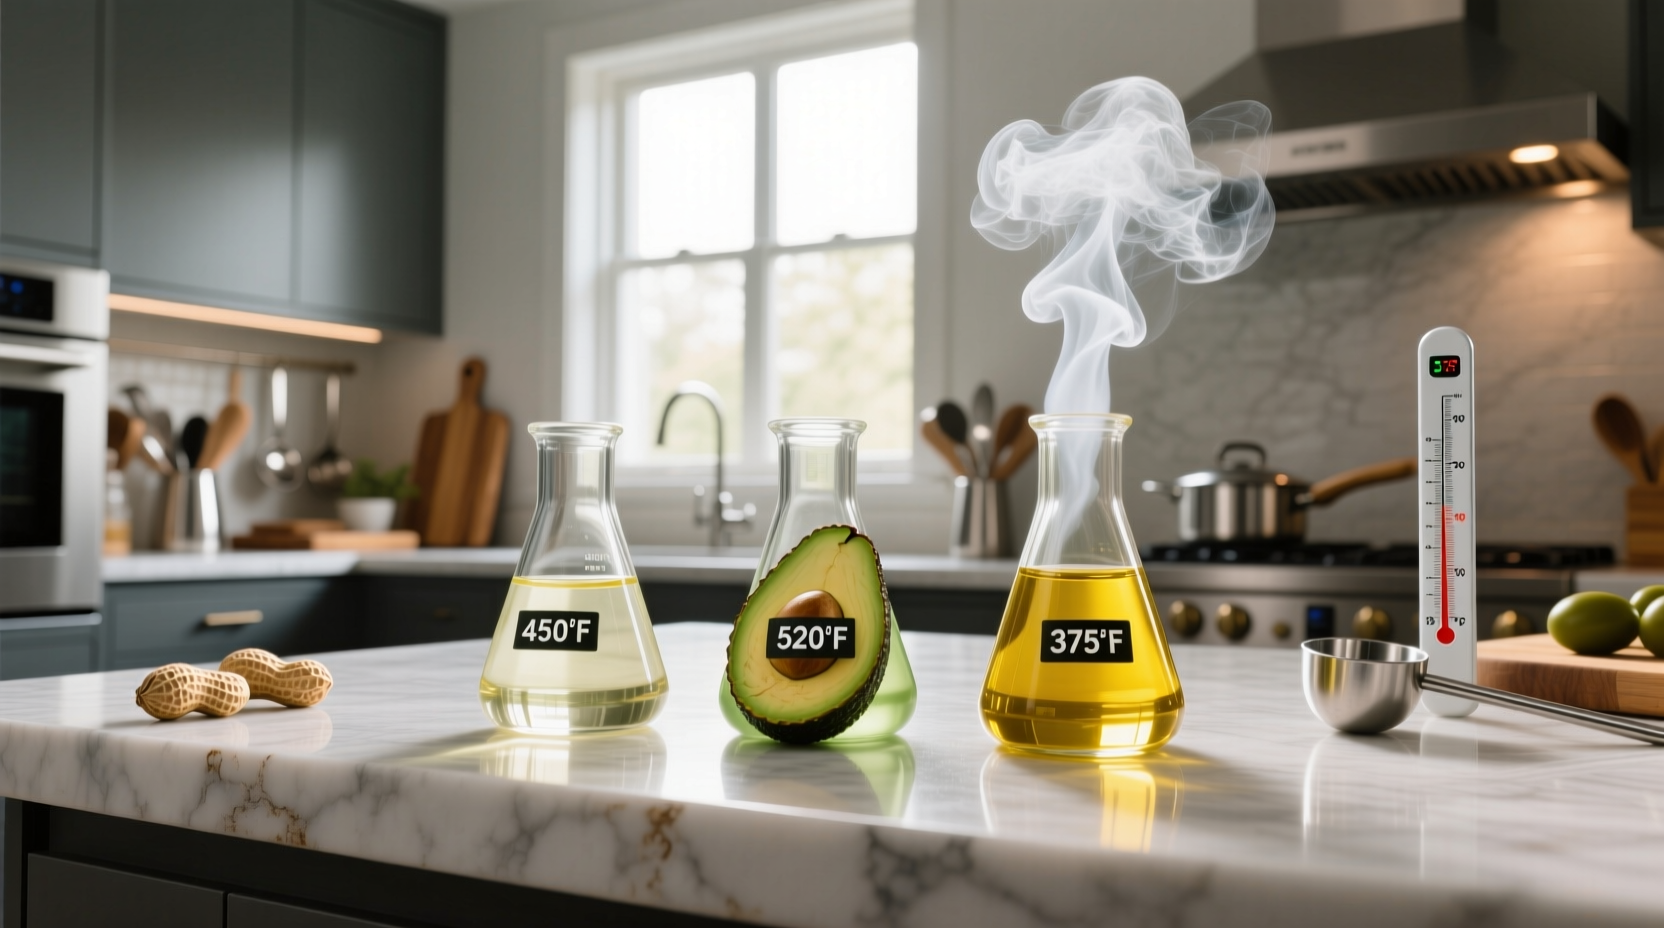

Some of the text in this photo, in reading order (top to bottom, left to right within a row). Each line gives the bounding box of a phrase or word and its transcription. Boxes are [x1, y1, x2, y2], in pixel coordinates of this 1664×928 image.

[521, 618, 591, 643] 450°F
[776, 625, 848, 650] 520°F
[1050, 628, 1123, 654] 375°F
